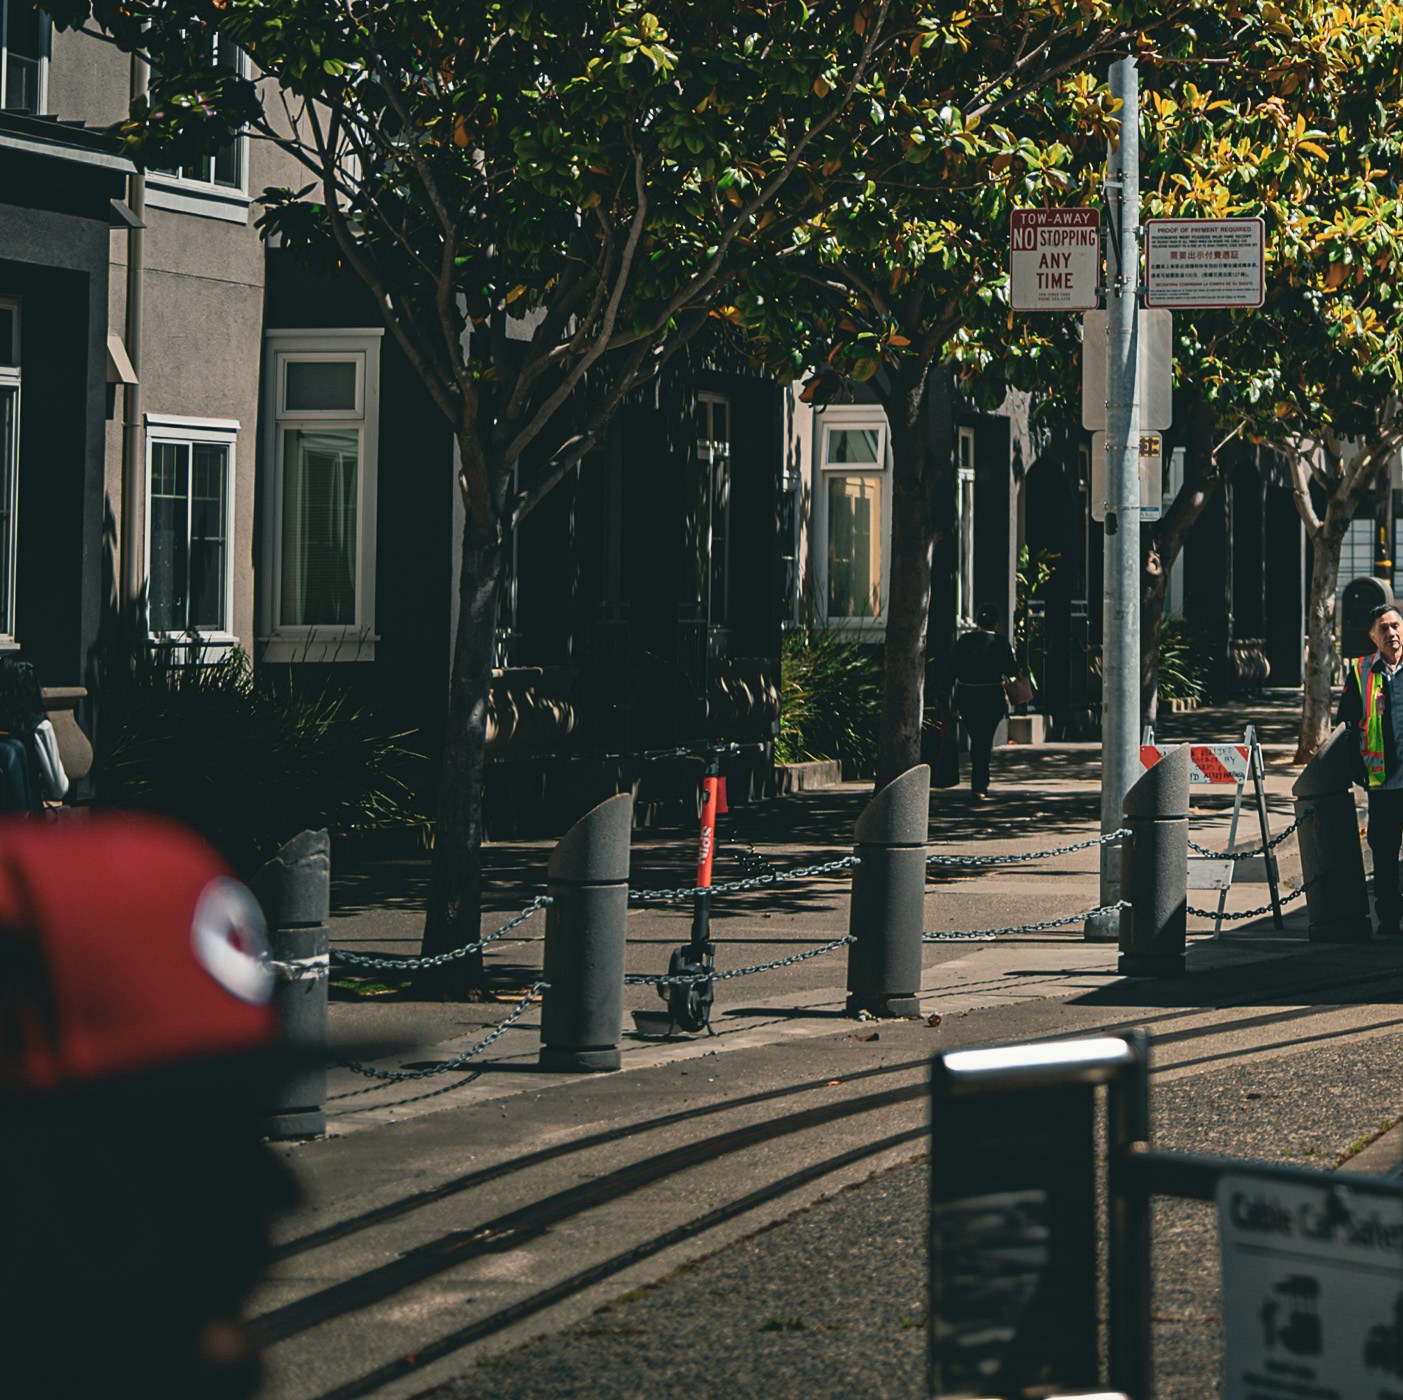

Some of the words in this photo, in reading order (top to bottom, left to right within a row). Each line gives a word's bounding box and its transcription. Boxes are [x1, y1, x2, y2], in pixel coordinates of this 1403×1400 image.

[1020, 213, 1091, 225] TOW-AWAY
[1013, 227, 1035, 250] NO
[1040, 229, 1096, 247] STOPPING
[1039, 252, 1072, 269] ANY
[1036, 272, 1073, 289] TIME
